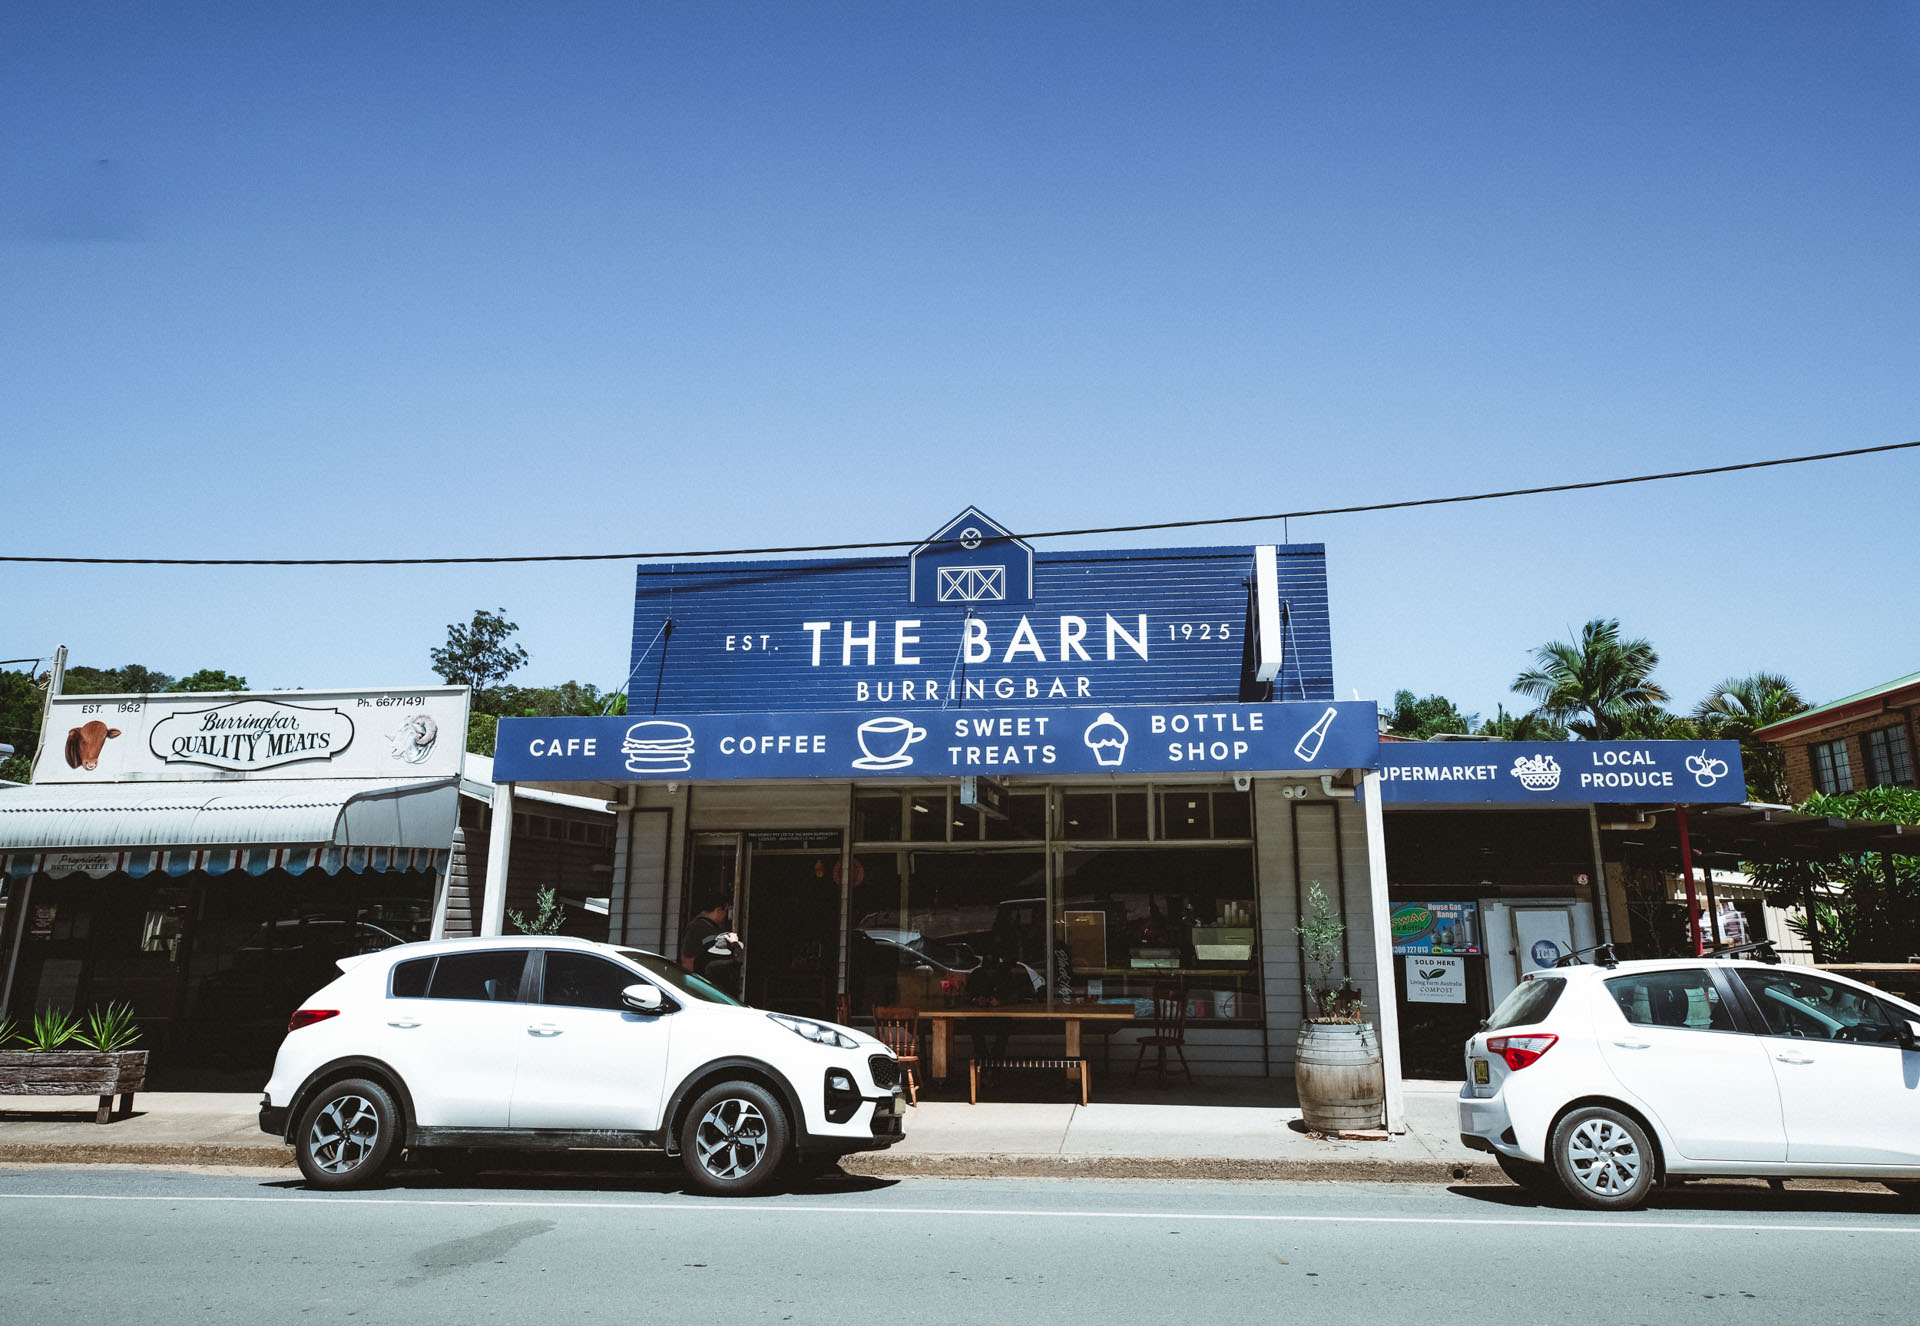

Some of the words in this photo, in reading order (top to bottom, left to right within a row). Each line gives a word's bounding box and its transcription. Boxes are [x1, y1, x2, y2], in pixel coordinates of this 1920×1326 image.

[803, 619, 921, 666] THE
[964, 612, 1149, 664] BARN
[1168, 623, 1231, 641] 1925
[725, 634, 779, 652] EST.
[857, 676, 1092, 702] BURRINGBAR
[81, 703, 104, 714] EST.
[117, 703, 141, 714] 1962
[357, 698, 374, 708] Ph.
[376, 697, 426, 708] 66771491
[199, 711, 300, 740] Burringbar
[954, 717, 1050, 737] SWEET
[1151, 712, 1265, 733] BOTTLE
[172, 734, 259, 761] QUALITY
[265, 732, 331, 758] MEATS
[529, 738, 598, 757] CAFE
[719, 735, 827, 755] COFFEE
[1168, 742, 1250, 761] SHOP
[948, 745, 1057, 765] TREATS
[1592, 750, 1657, 766] LOCAL
[1379, 765, 1498, 781] UPERMARKET
[1580, 771, 1674, 788] PRODUCE
[1427, 903, 1448, 911] House
[1449, 903, 1462, 911] Gas
[1437, 911, 1458, 919] Range
[1391, 911, 1428, 928] SWAP
[1536, 947, 1557, 960] ICE
